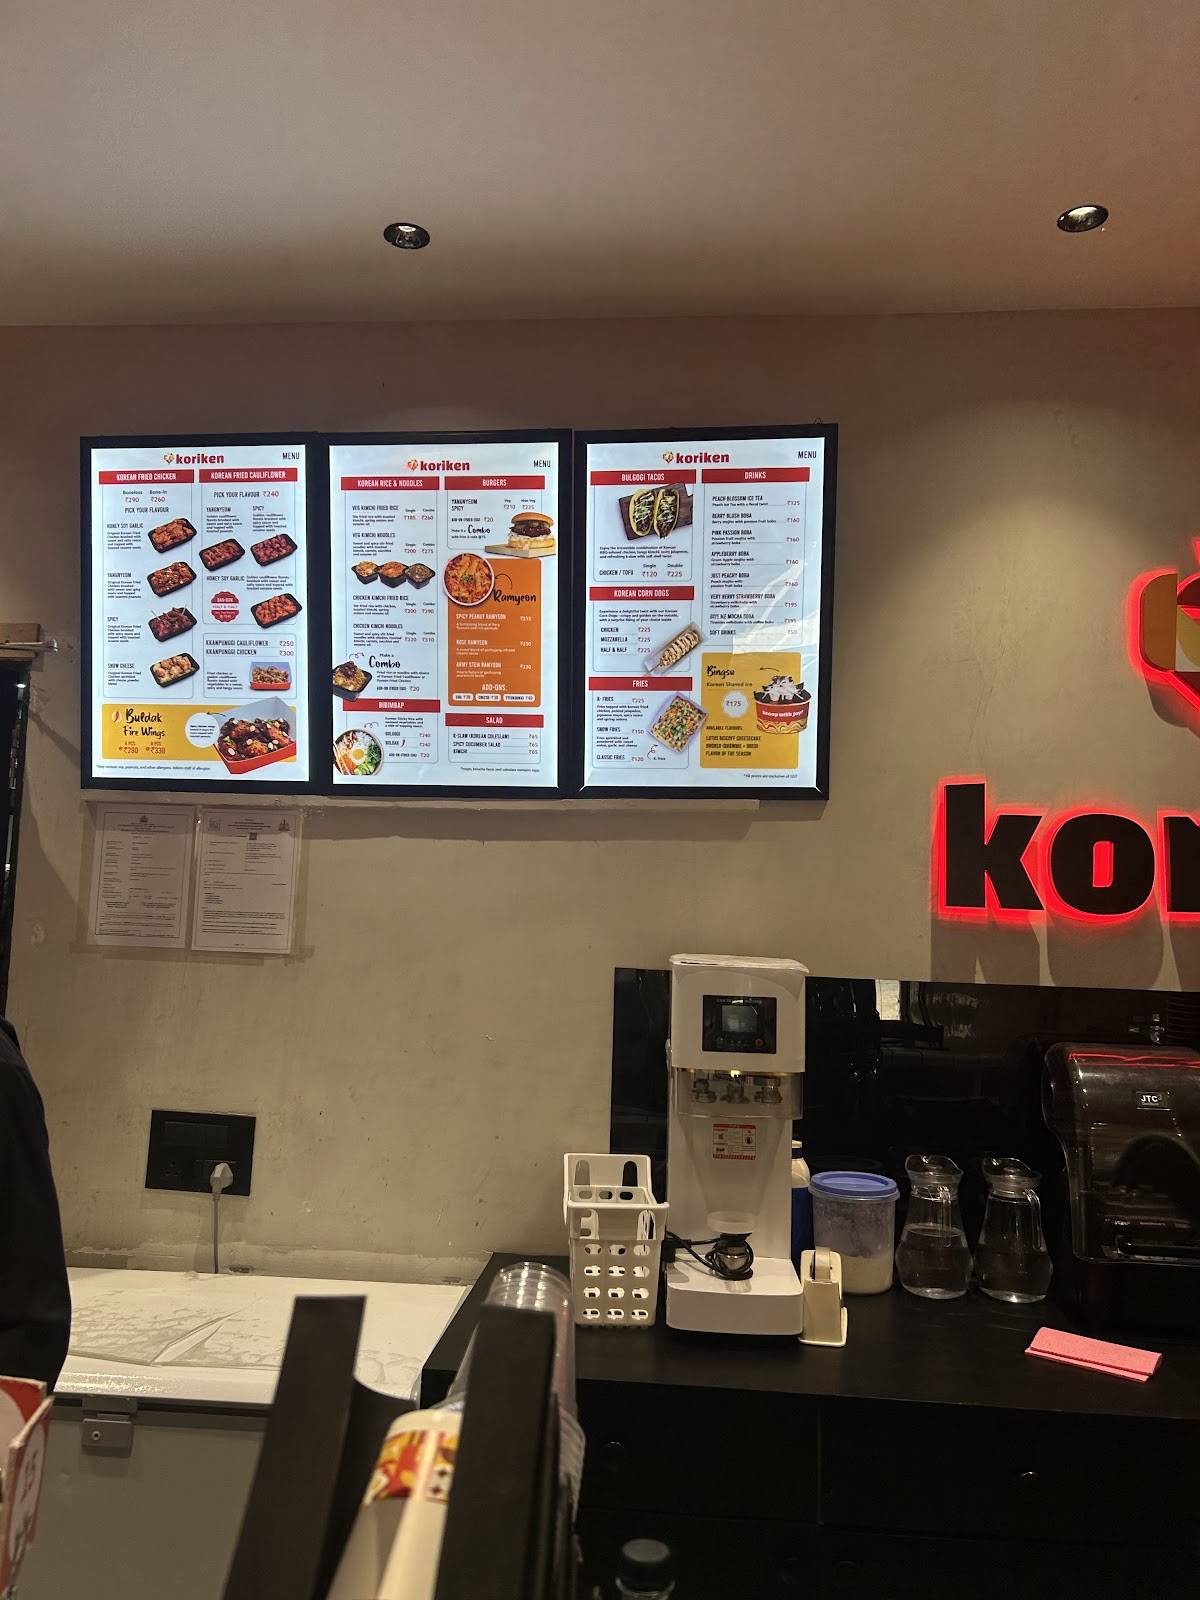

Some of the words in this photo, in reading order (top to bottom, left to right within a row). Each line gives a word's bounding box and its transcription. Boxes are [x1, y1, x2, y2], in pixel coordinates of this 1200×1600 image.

[176, 454, 224, 464] koriken
[282, 452, 300, 460] MENU
[676, 452, 730, 464] koriken
[797, 451, 817, 460] MENU
[420, 460, 470, 472] koriken
[533, 460, 551, 468] MENU
[117, 473, 137, 481] KOREAN
[138, 473, 153, 481] FRIED
[154, 472, 177, 480] CHICKEN
[211, 472, 232, 480] KOREAN
[233, 472, 249, 480] FRIED
[249, 471, 286, 479] CAULIFLOWER
[621, 474, 646, 482] BULGOGI
[647, 473, 665, 481] TACOS
[744, 472, 767, 480] DRINKS
[399, 479, 423, 487] NOODLES
[468, 524, 491, 534] Combo
[493, 589, 536, 605] Ramyeon
[369, 655, 401, 668] Combo
[706, 665, 735, 679] Bingsu
[632, 680, 649, 688] FRIES
[126, 708, 162, 723] Buldak
[123, 725, 139, 736] Fire
[141, 726, 165, 739] Wings
[1141, 1095, 1158, 1103] JTC
